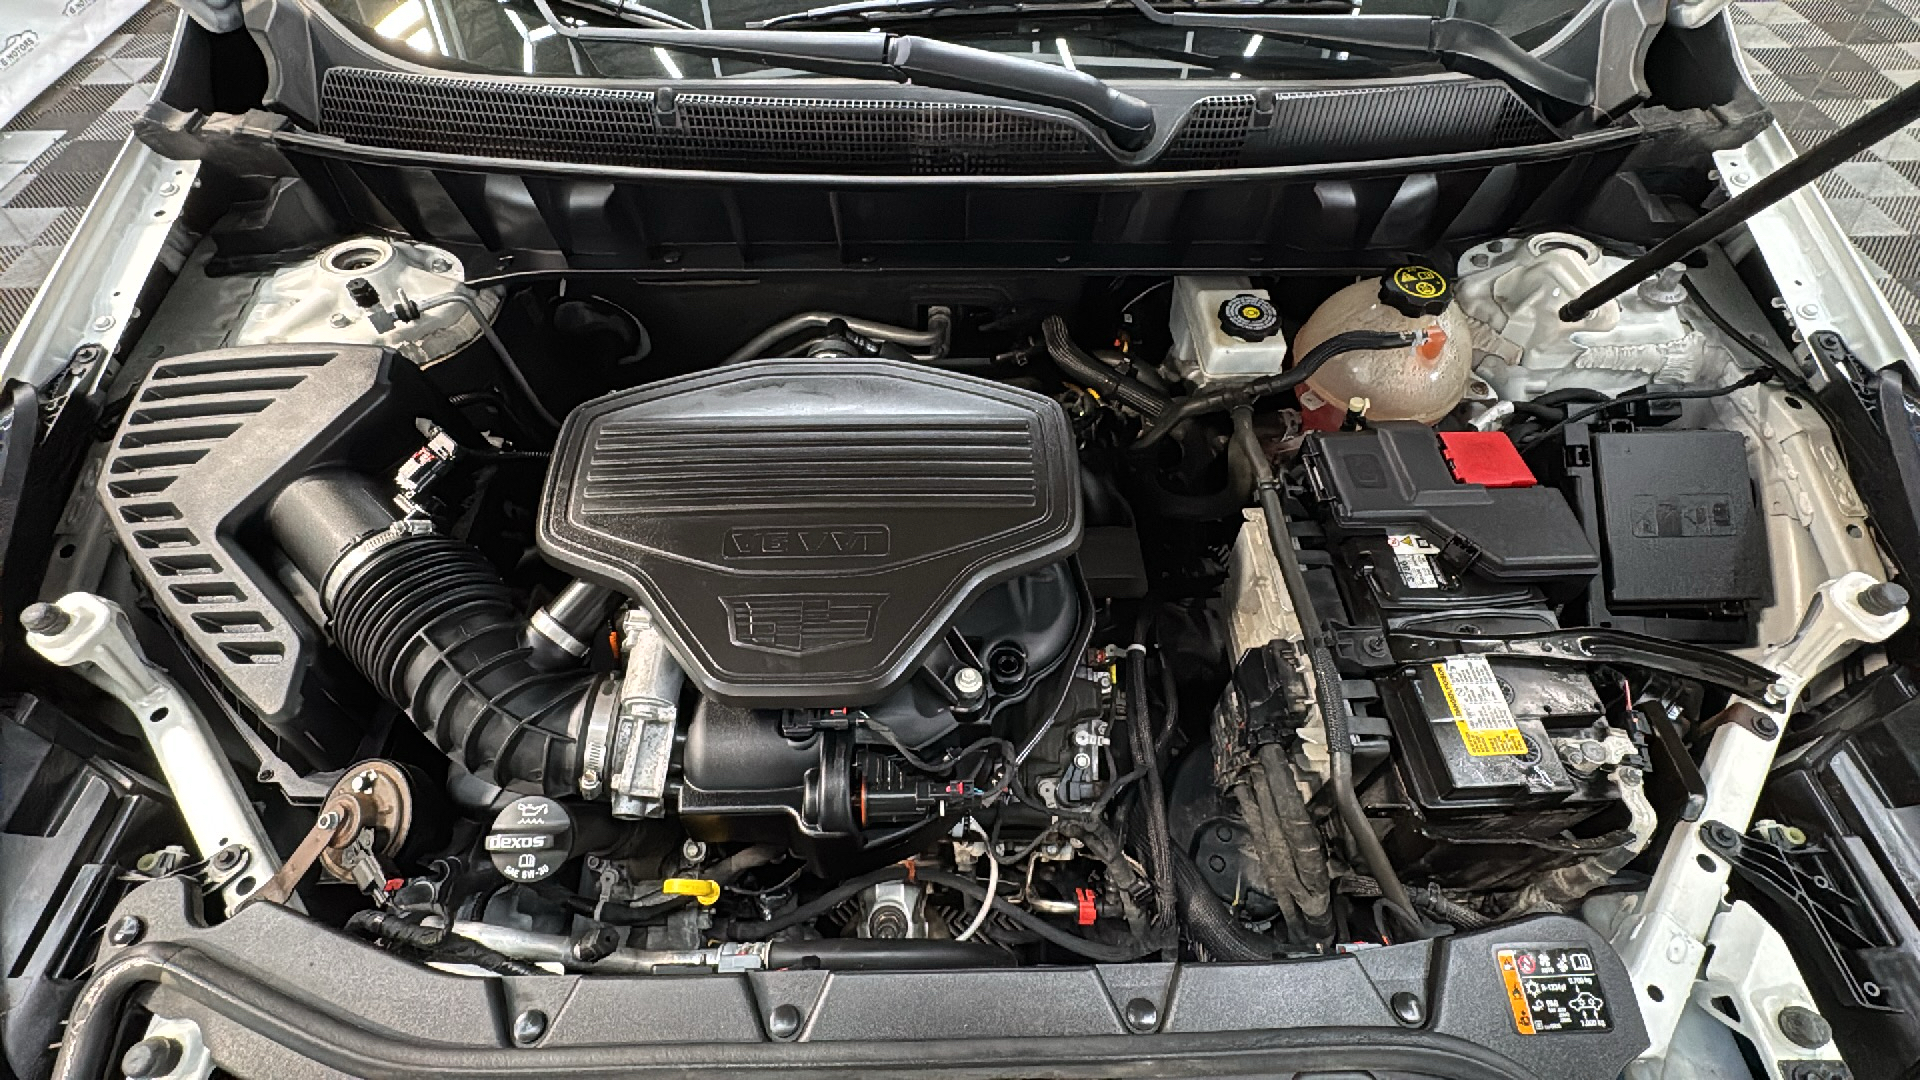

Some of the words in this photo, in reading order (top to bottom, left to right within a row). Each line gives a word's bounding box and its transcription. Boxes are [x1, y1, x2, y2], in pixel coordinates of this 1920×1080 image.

[6, 37, 35, 61] MOTORS
[489, 833, 547, 849] dexos
[504, 865, 520, 878] SAE
